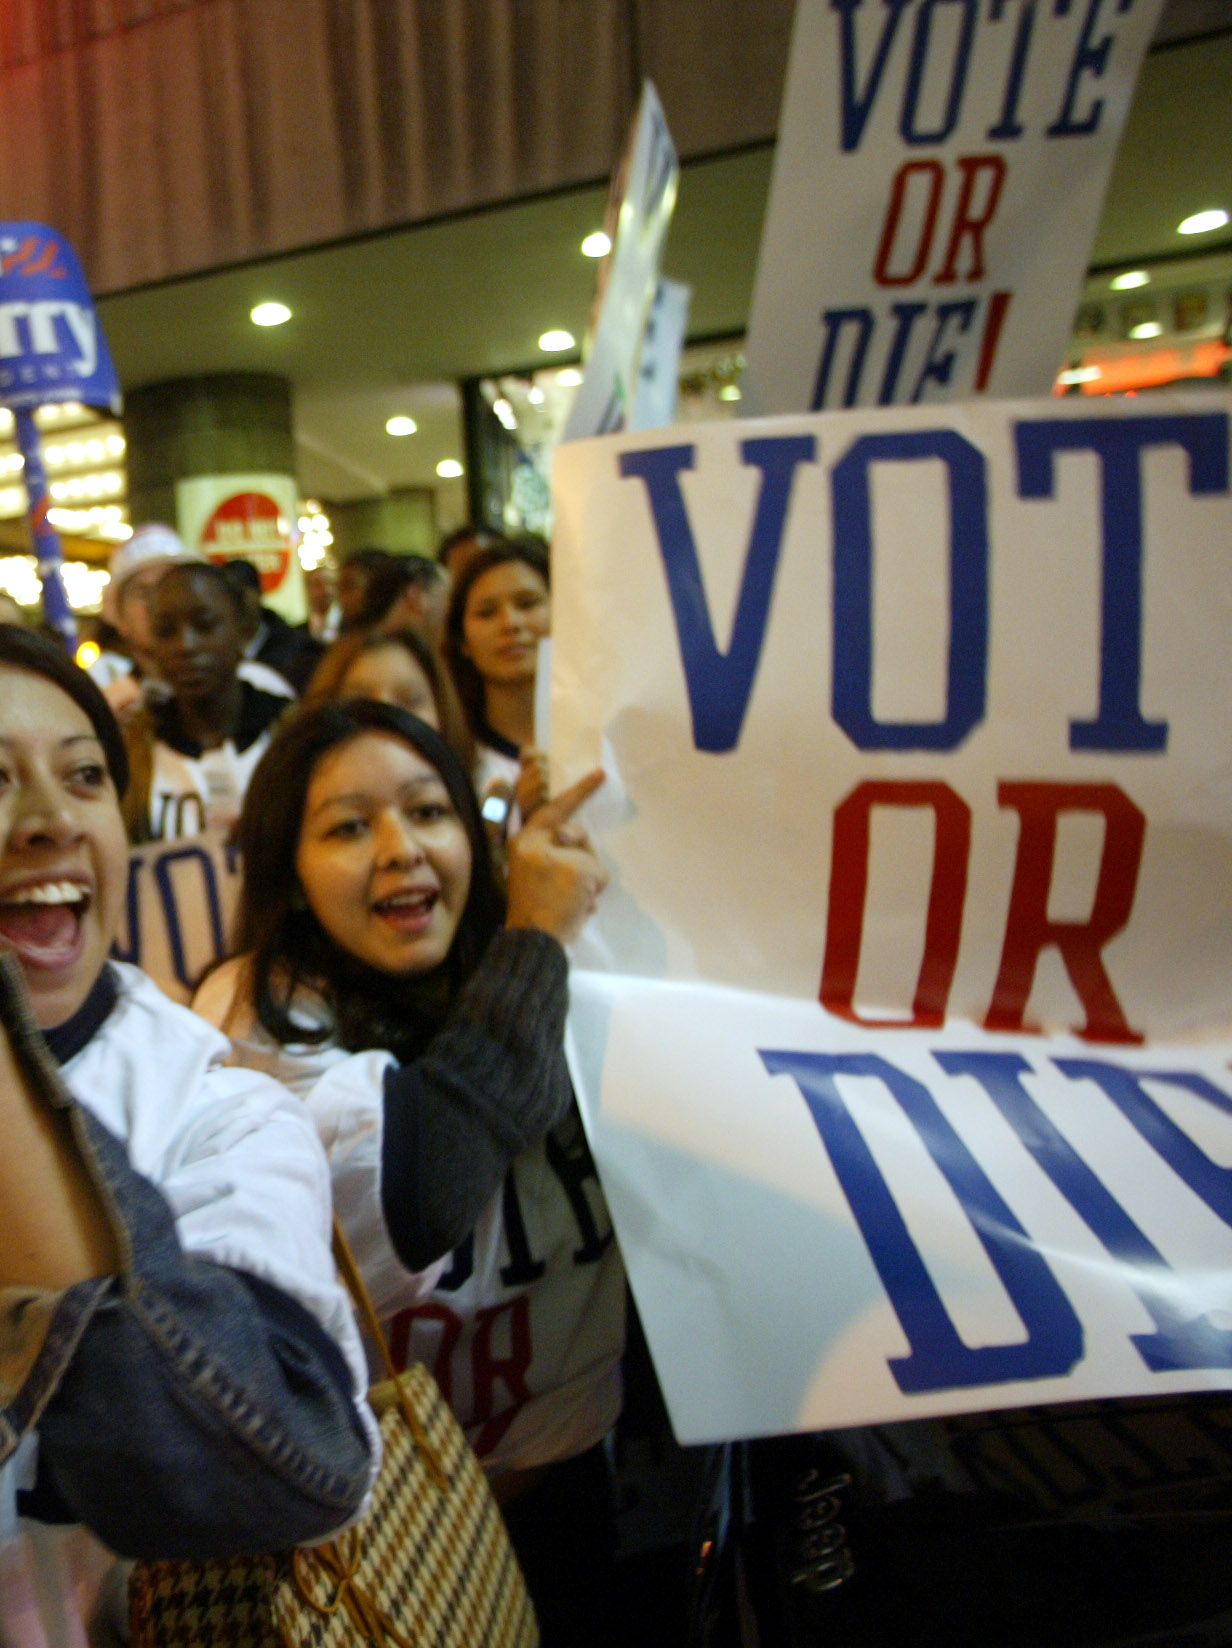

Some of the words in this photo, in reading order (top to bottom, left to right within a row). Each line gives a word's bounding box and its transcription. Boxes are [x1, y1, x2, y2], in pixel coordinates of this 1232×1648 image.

[828, 0, 1134, 152] VOTE
[872, 155, 1006, 289] OR
[818, 779, 1146, 1047] OR
